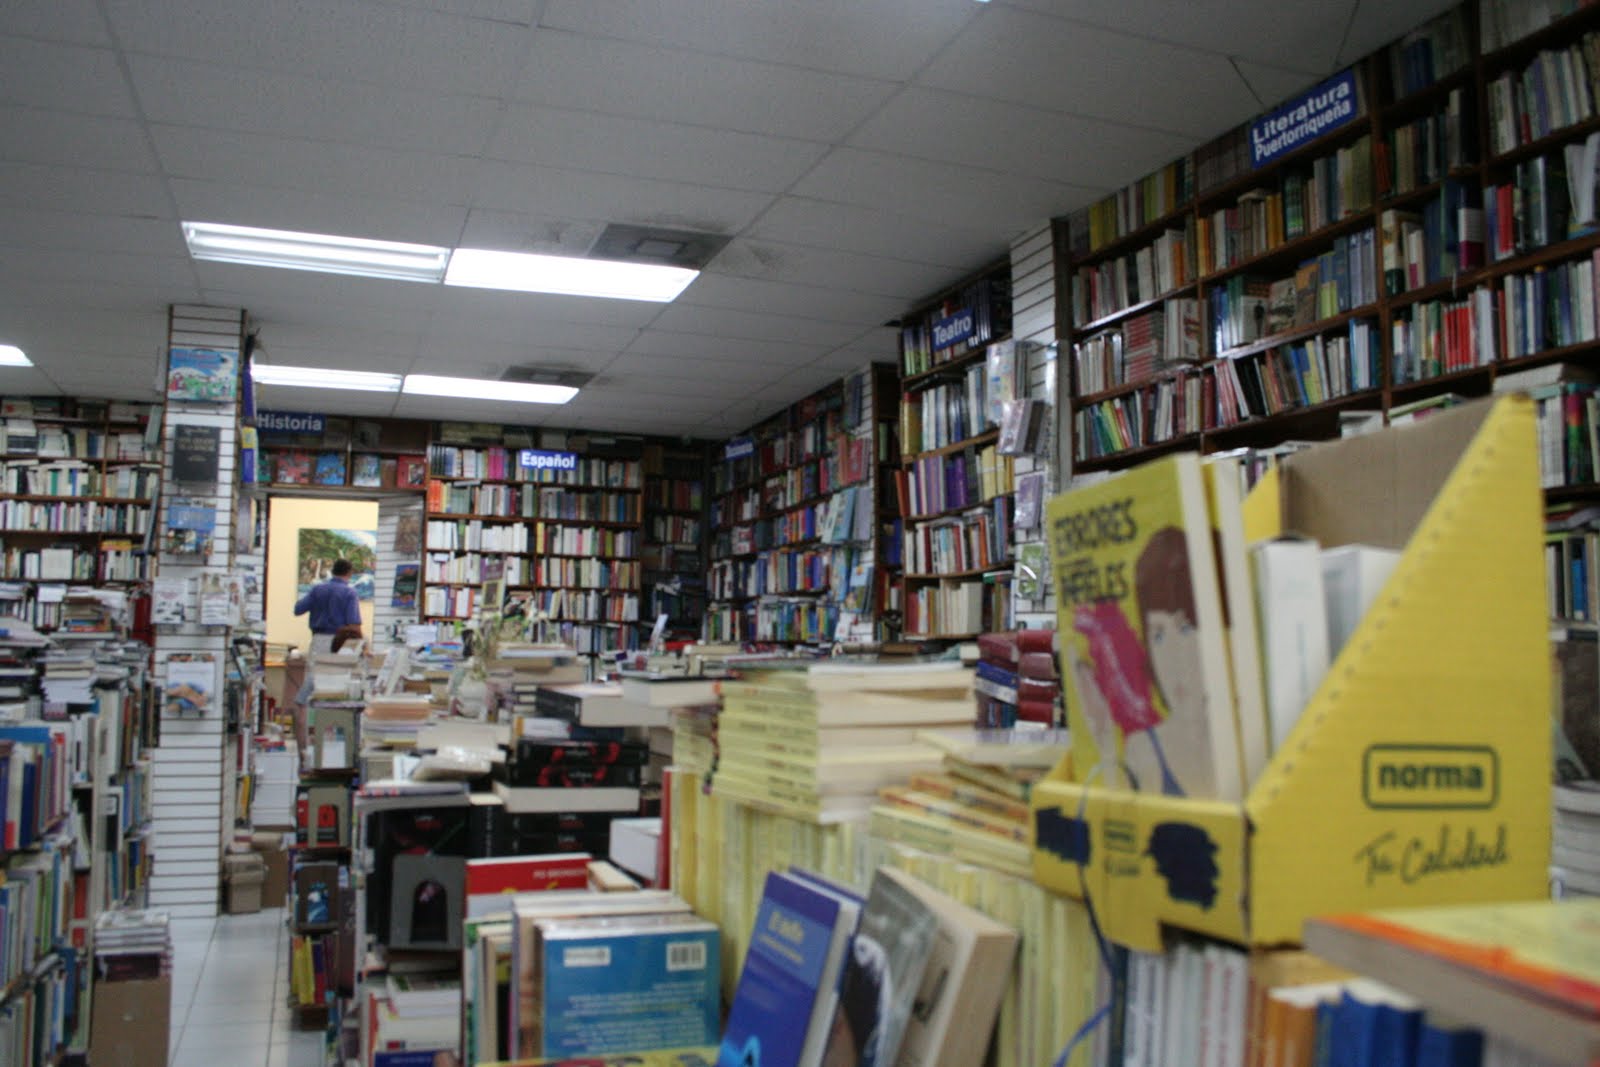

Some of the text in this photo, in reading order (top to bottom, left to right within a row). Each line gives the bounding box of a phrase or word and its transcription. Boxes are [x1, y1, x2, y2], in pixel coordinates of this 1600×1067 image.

[1253, 82, 1349, 144] Literatura
[1254, 99, 1352, 162] Puertorriqueña
[932, 315, 972, 347] Teatro
[257, 413, 322, 431] Historia
[521, 451, 575, 469] Español
[1378, 765, 1484, 790] norma
[1400, 820, 1511, 885] Calidad
